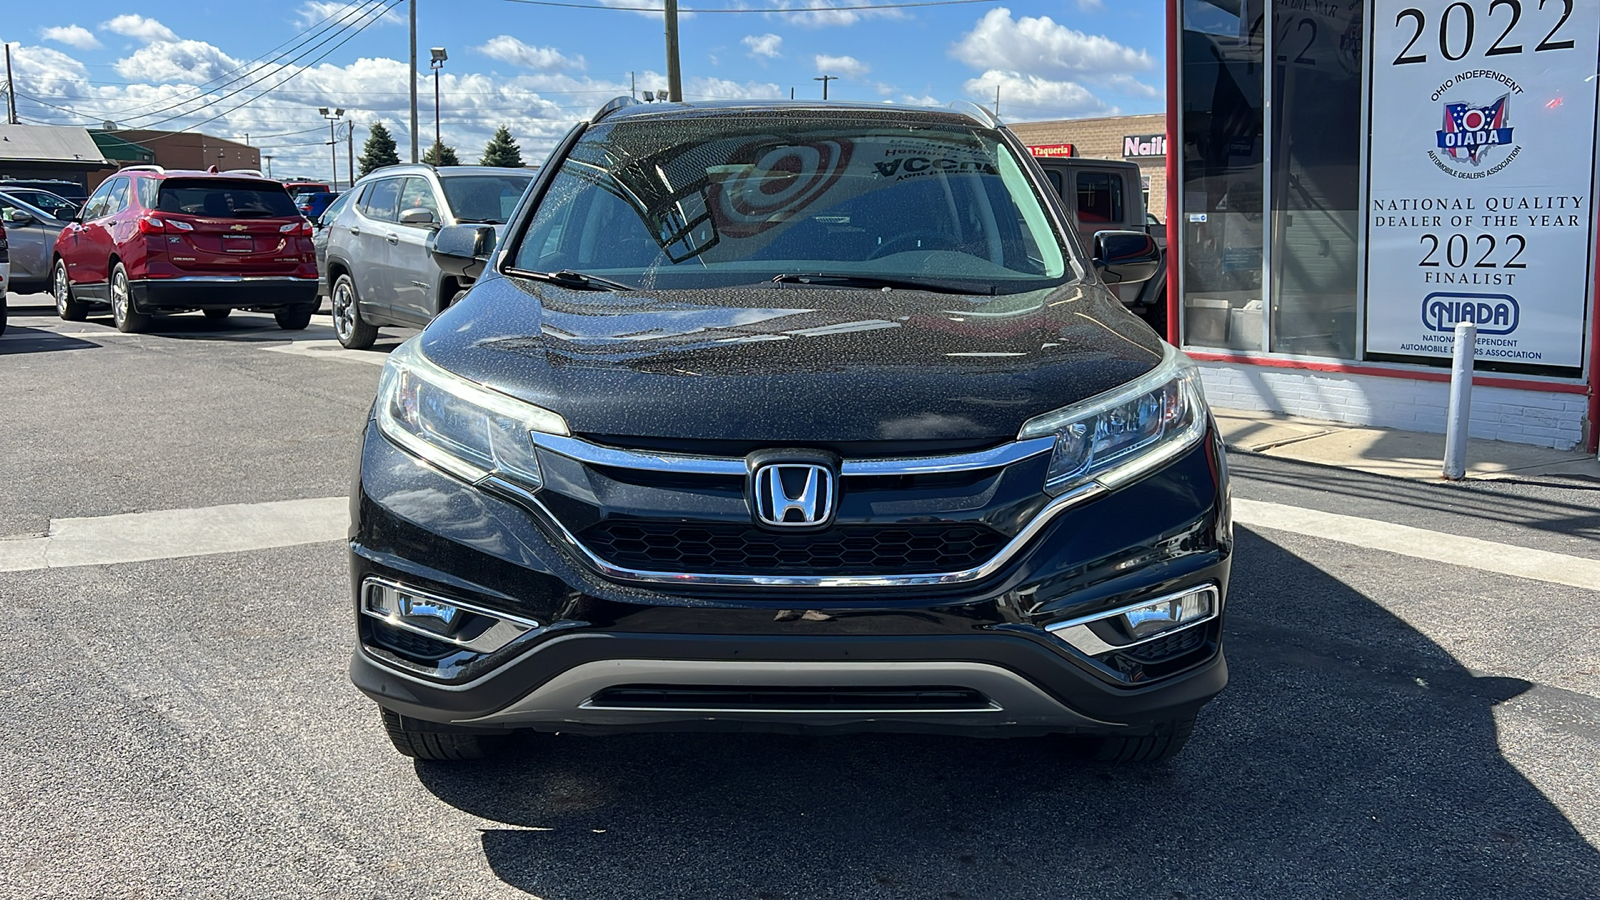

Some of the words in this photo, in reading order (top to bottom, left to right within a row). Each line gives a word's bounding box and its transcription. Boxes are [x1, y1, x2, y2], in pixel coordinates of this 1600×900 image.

[1393, 0, 1575, 65] 2022
[1431, 80, 1453, 102] OHIO
[1455, 70, 1523, 95] INDEPENDENT
[1445, 130, 1499, 146] OIADA
[1034, 146, 1069, 157] Taqueria
[1427, 150, 1457, 178] AUTOMOBILE
[1458, 171, 1485, 179] DEALERS
[1487, 145, 1522, 176] ASSOCIATION
[1373, 198, 1475, 211] NATIONAL
[1486, 196, 1584, 212] QUALITY
[1375, 215, 1442, 227] DEALER
[1451, 216, 1473, 227] OF
[1482, 215, 1518, 227] THE
[1528, 215, 1580, 227] YEAR
[1418, 234, 1527, 269] 2022
[1425, 272, 1516, 285] FINALIST
[1430, 301, 1509, 327] NIADA
[1422, 335, 1455, 343] NATIONA
[1475, 337, 1518, 347] EPENDENT
[1400, 343, 1448, 353] AUTOMOBILE
[1485, 349, 1542, 359] ASSOCIATION
